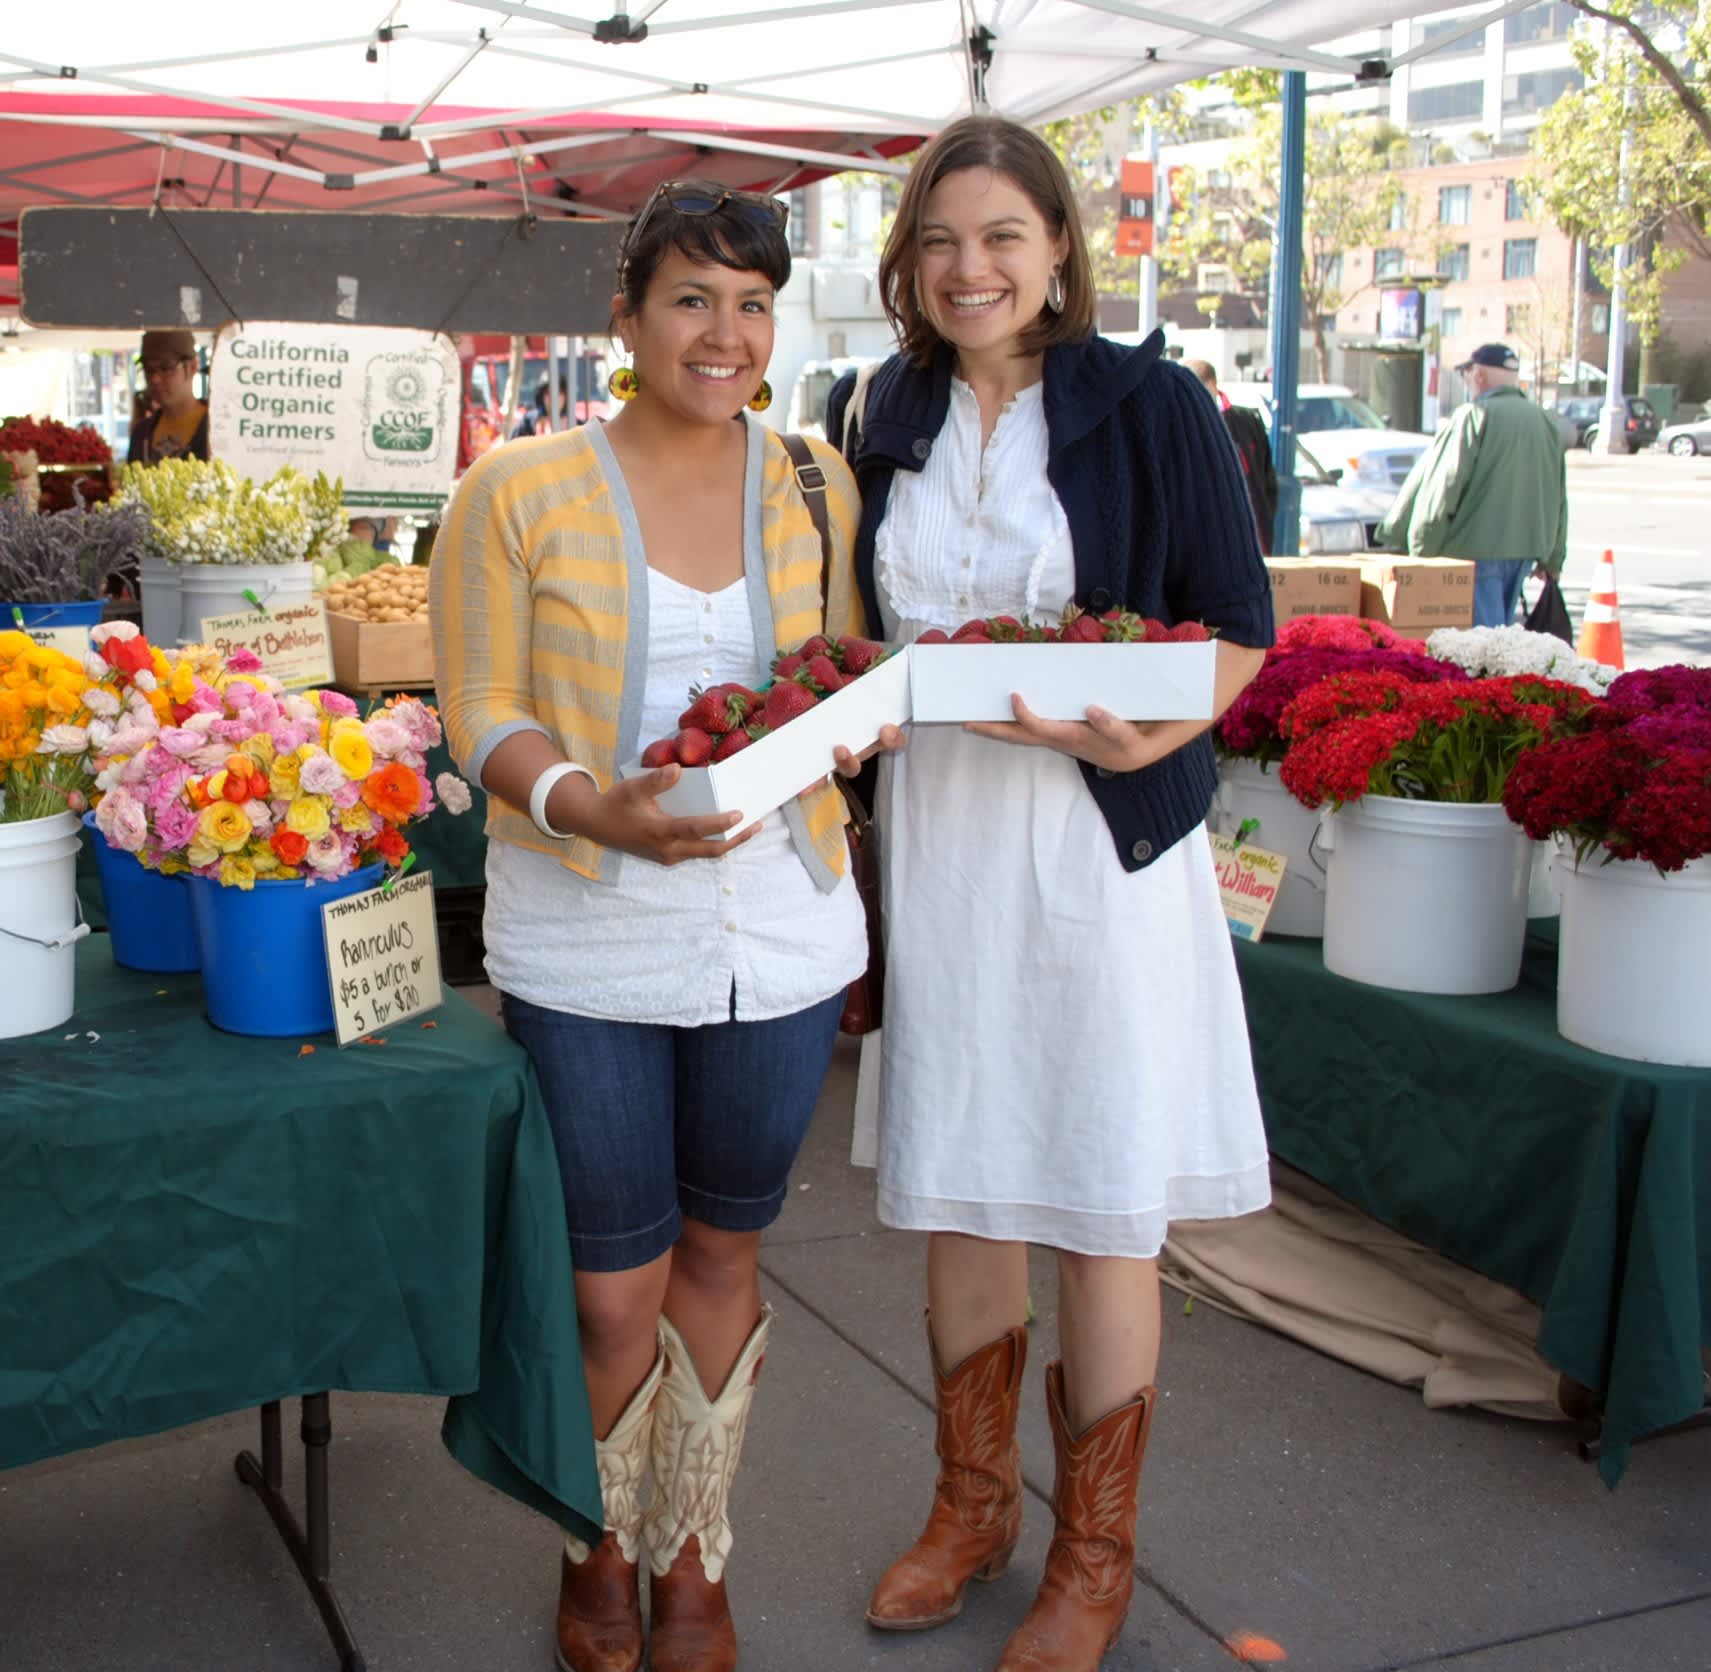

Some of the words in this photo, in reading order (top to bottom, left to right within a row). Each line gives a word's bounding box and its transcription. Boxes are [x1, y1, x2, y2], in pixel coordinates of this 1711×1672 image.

[230, 339, 350, 363] California
[236, 366, 342, 389] Certified
[242, 392, 335, 417] Organic
[239, 419, 335, 441] Farmers
[380, 410, 430, 432] CCOF
[1240, 851, 1280, 875] organic
[1221, 860, 1276, 904] William
[328, 895, 370, 919] THOMAS
[340, 977, 358, 1008] $5
[361, 977, 370, 996] a
[374, 962, 408, 991] bunch
[411, 955, 424, 974] or
[353, 1010, 365, 1031] 5
[371, 998, 391, 1023] for
[394, 984, 420, 1012] $20
